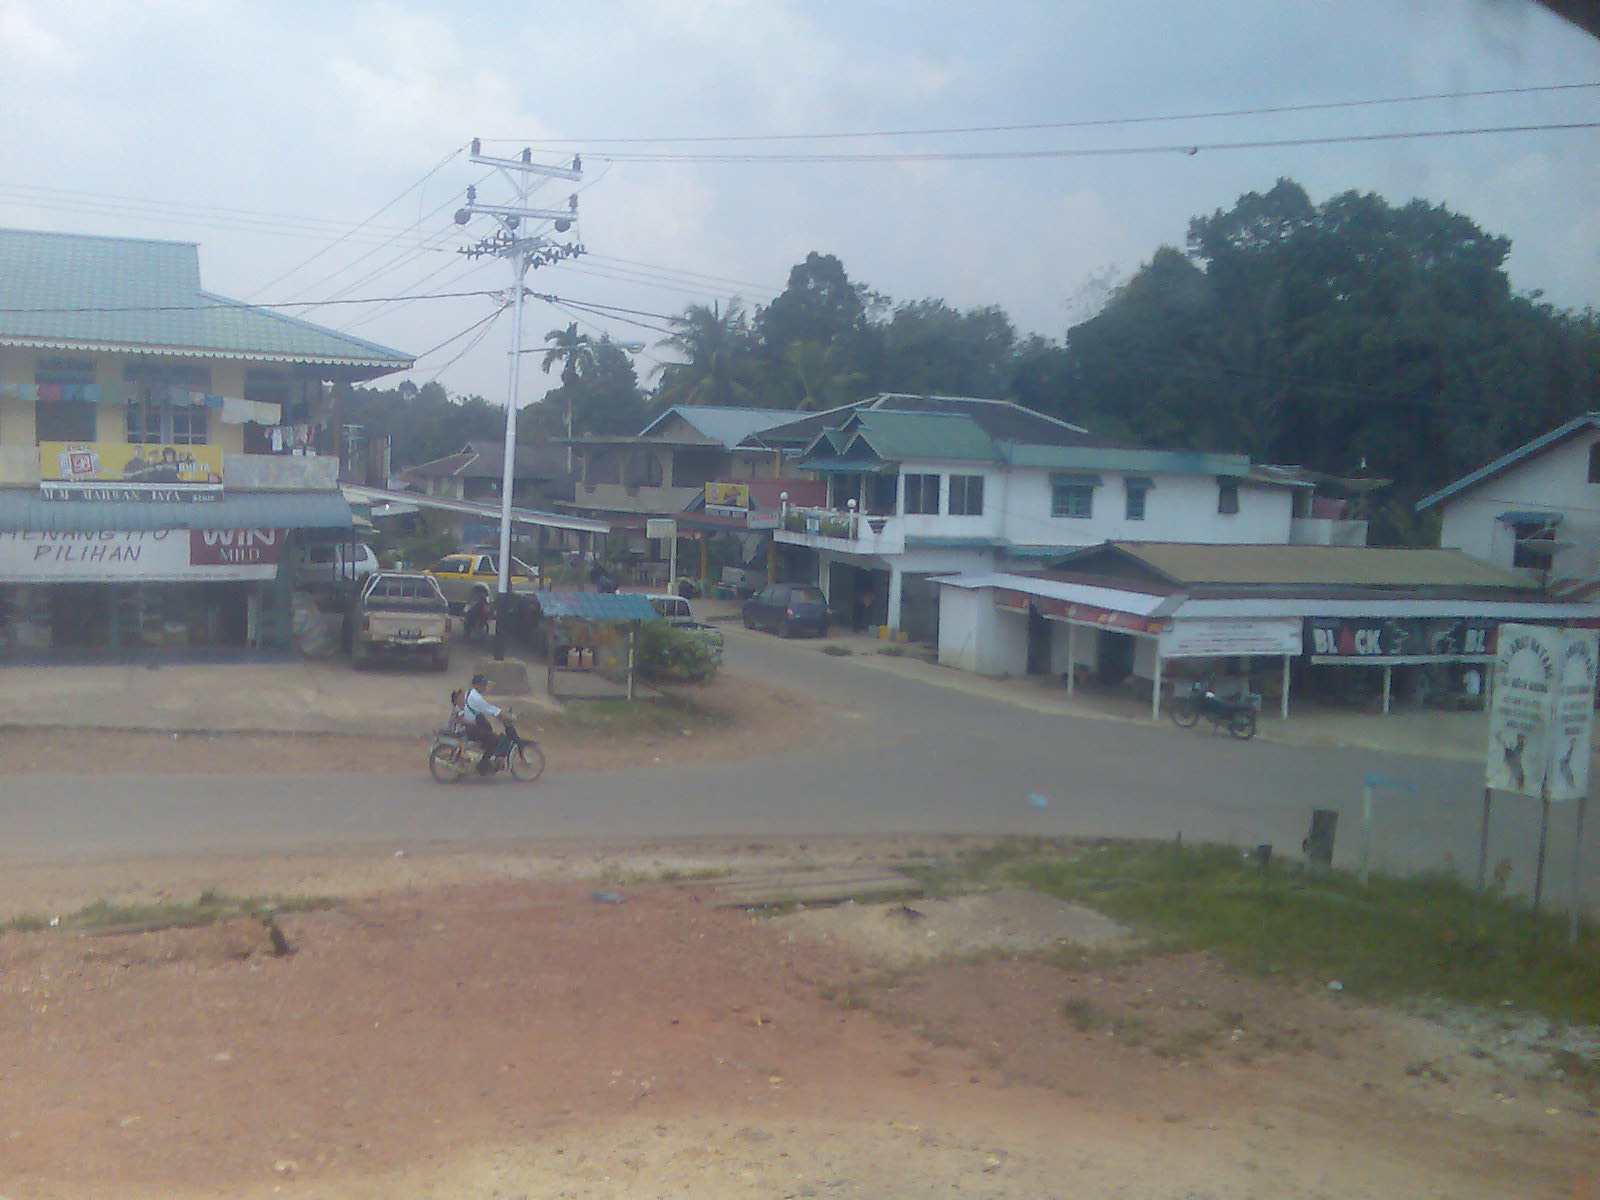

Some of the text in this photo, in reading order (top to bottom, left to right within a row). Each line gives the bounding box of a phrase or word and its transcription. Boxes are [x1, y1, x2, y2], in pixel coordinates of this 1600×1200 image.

[202, 528, 276, 546] WIN
[33, 544, 142, 562] PILIHAN
[220, 548, 260, 562] MILD
